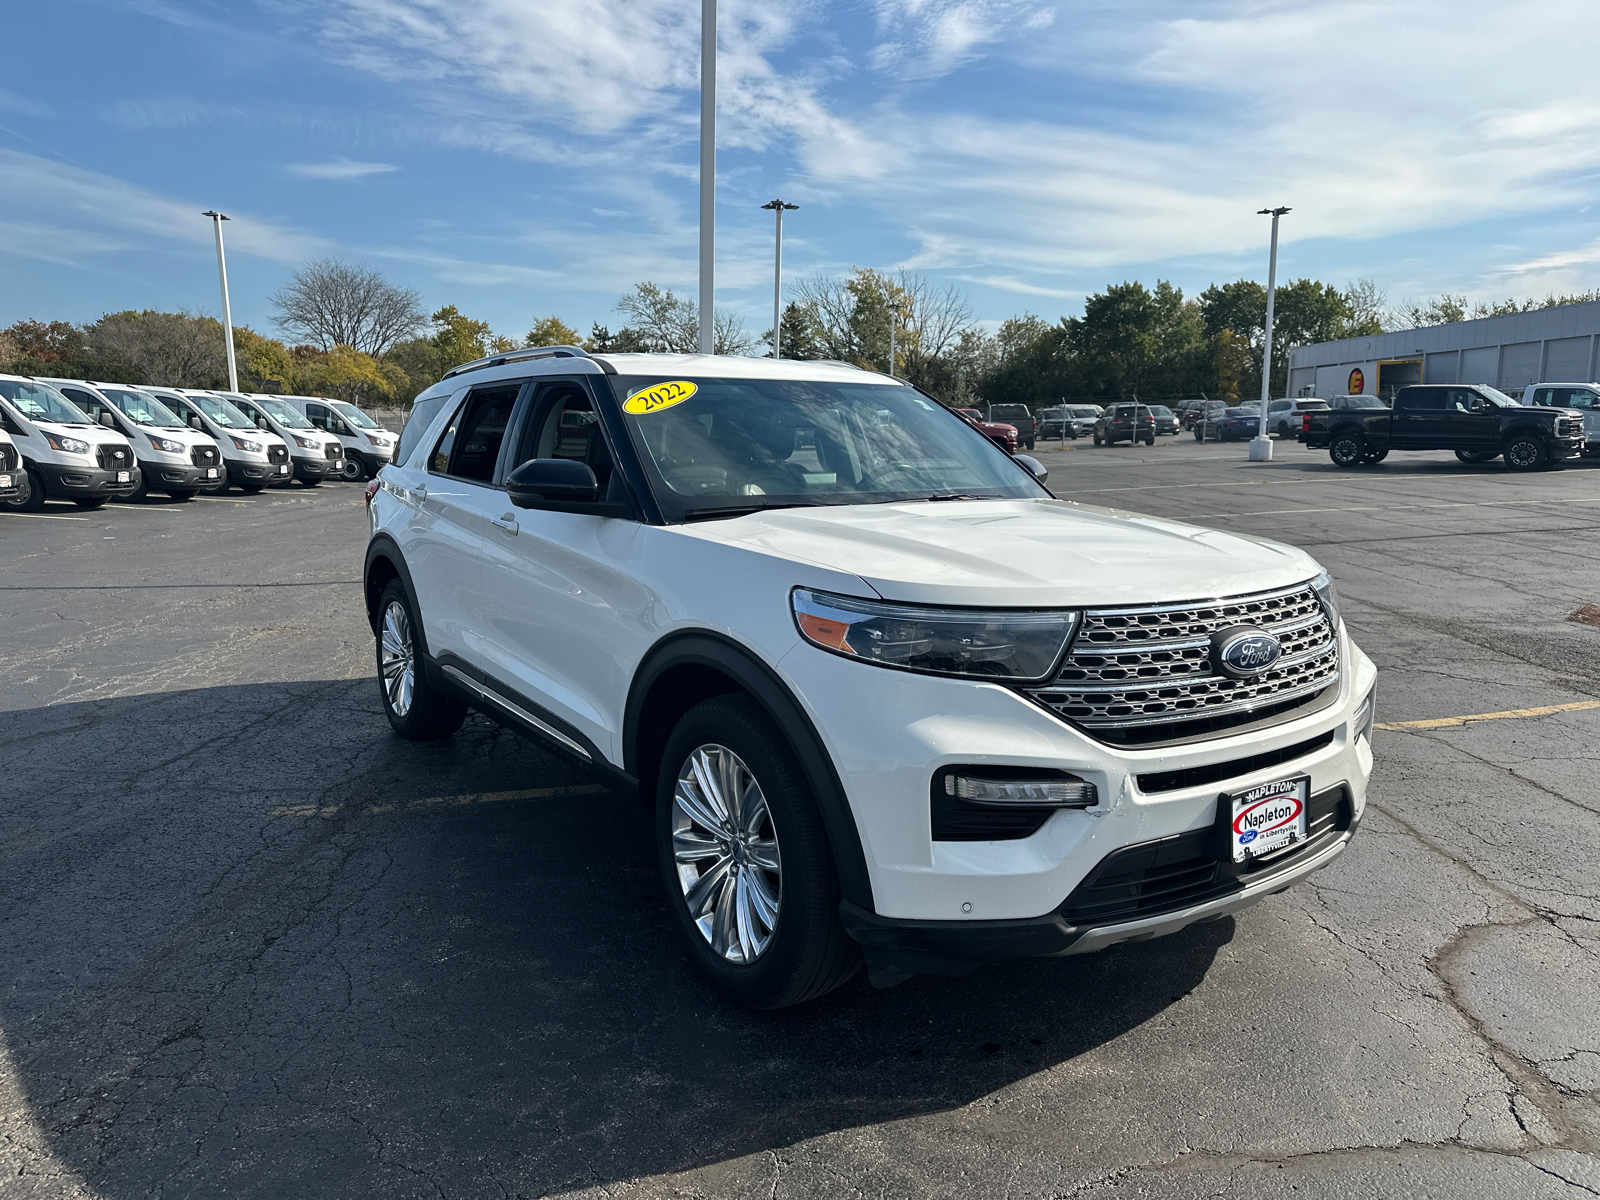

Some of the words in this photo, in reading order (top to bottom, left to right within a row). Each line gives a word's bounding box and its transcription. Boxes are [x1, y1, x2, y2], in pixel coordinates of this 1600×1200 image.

[1350, 374, 1362, 393] E
[638, 384, 686, 410] 2022
[1240, 643, 1271, 666] Ford
[1249, 782, 1292, 802] NAPLETON
[1244, 806, 1291, 830] Napleton
[1242, 831, 1255, 843] Ford
[1266, 825, 1297, 838] Libertyville
